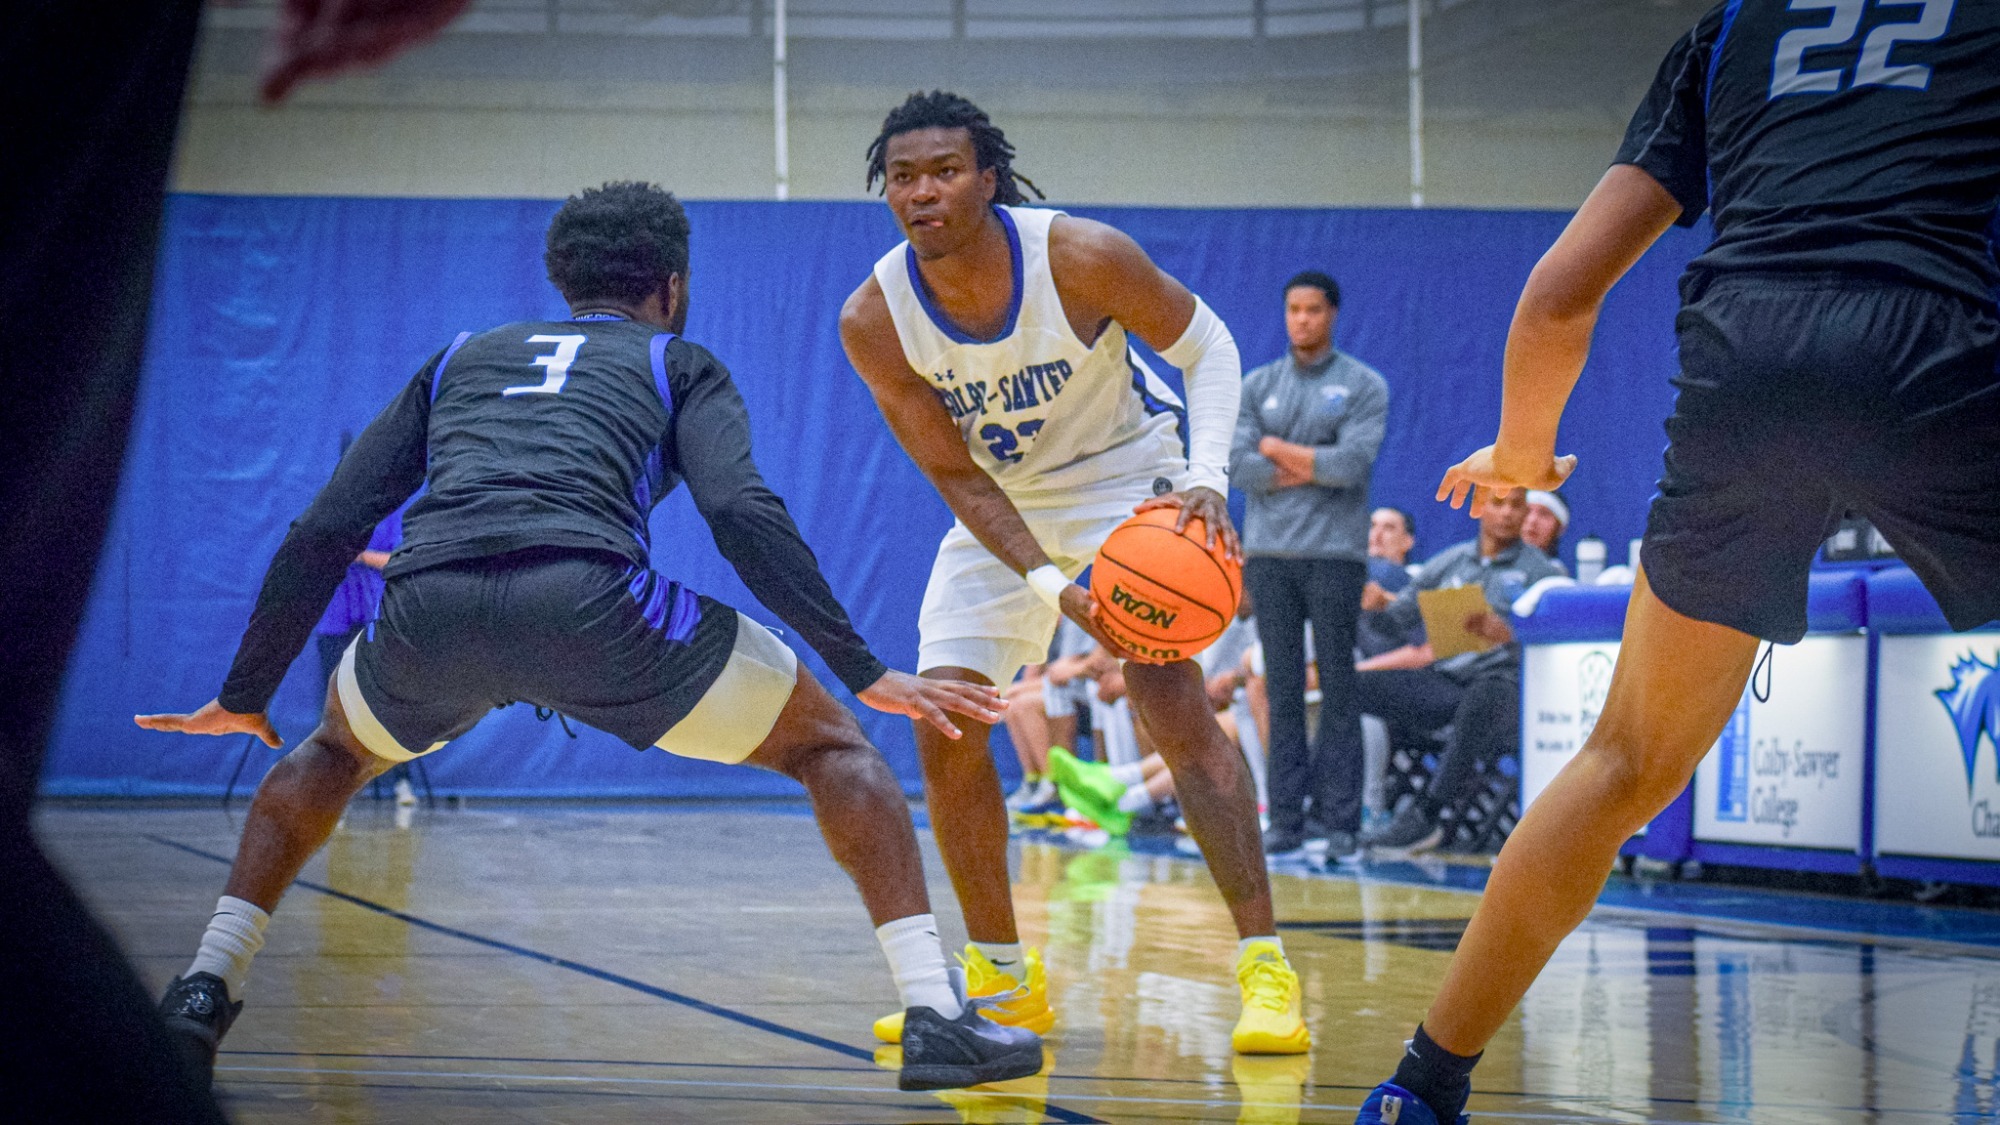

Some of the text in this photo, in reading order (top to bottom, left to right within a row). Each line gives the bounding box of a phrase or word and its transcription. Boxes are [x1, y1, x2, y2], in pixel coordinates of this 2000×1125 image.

[1767, 0, 1957, 101] 22
[502, 334, 588, 397] 3
[1110, 584, 1178, 629] NCAA
[1751, 785, 1799, 838] College
